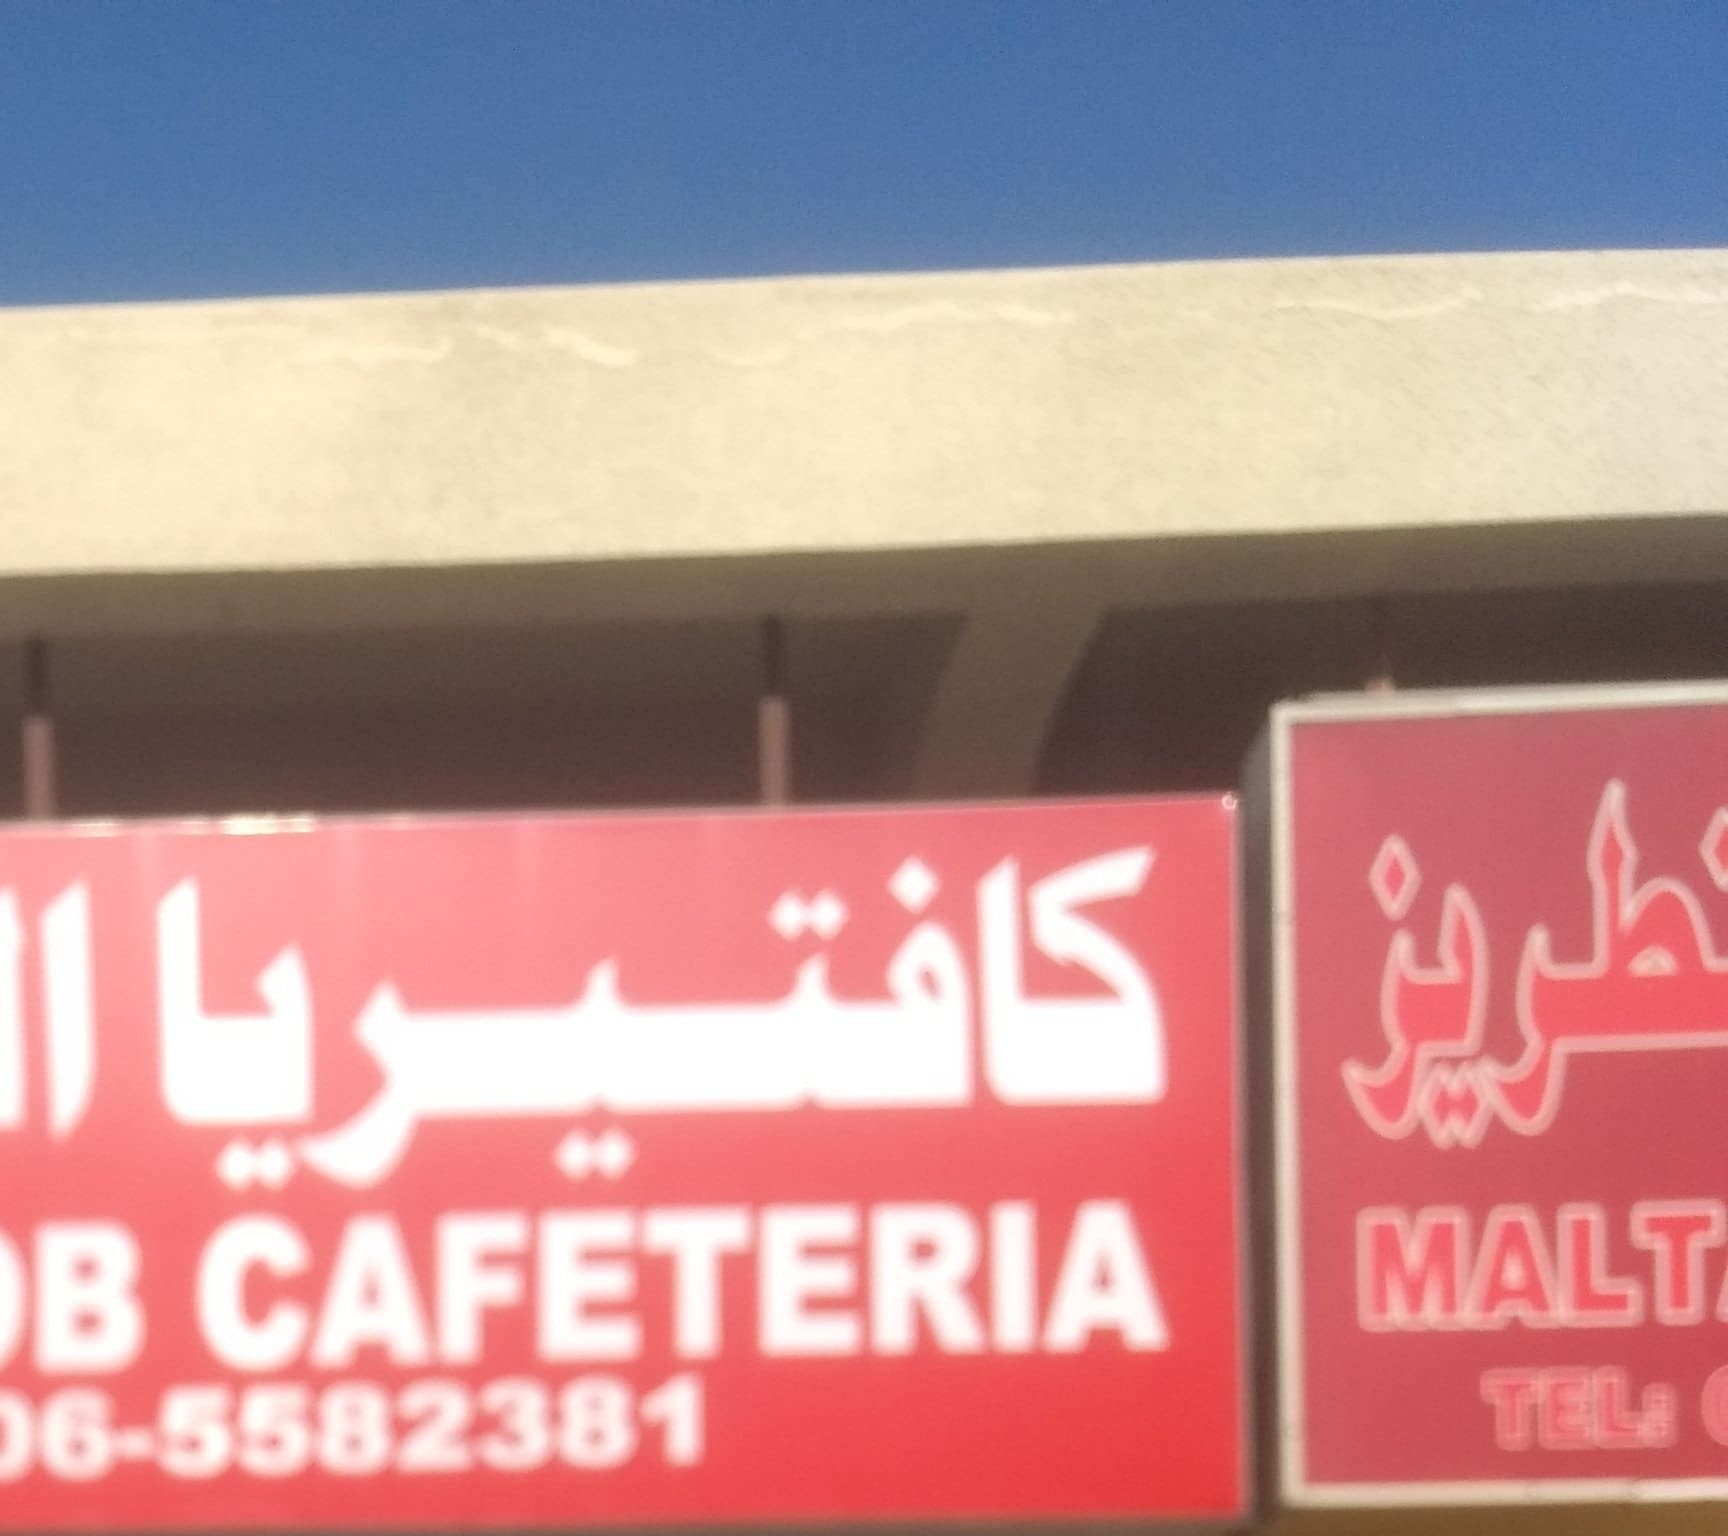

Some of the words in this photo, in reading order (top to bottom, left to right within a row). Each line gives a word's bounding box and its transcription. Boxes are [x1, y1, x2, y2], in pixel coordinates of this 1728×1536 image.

[154, 844, 1168, 1188] كافتيريا
[1340, 776, 1728, 1148] طريز
[194, 1198, 1170, 1373] CAFETERIA
[1355, 1198, 1728, 1332] MALT
[1479, 1365, 1678, 1452] TEL:
